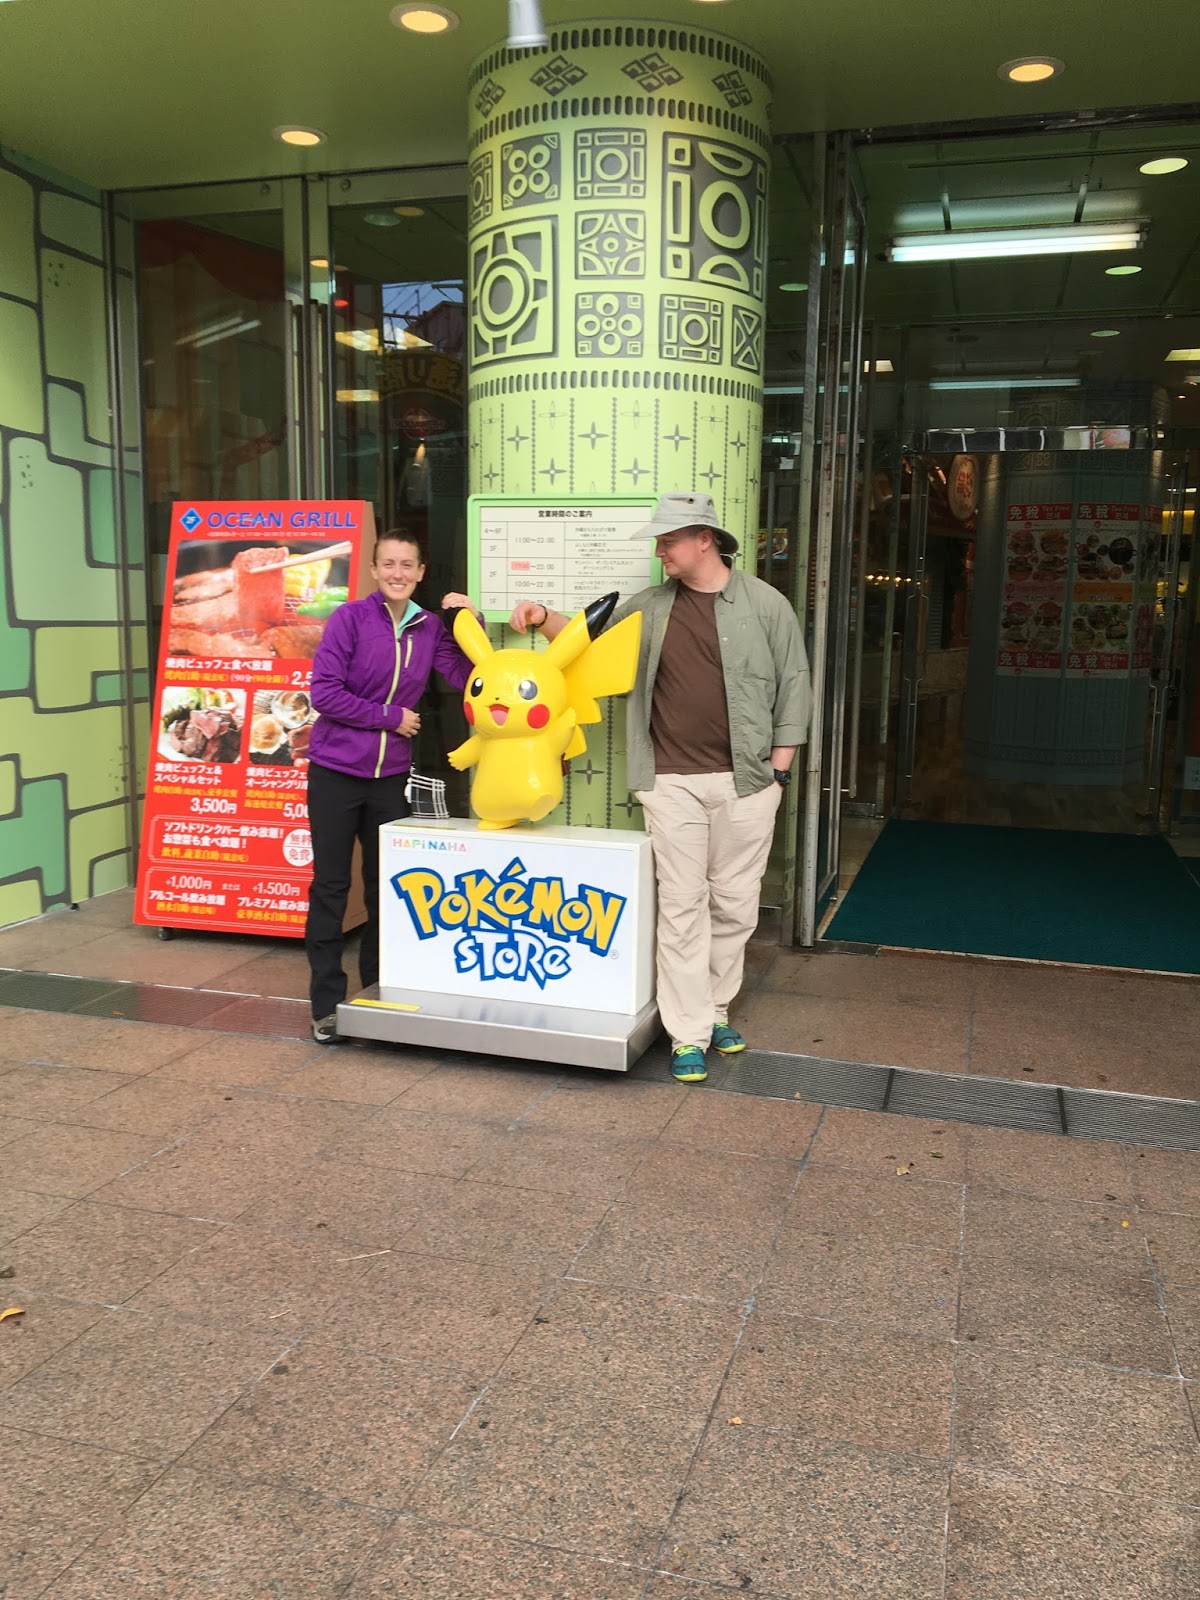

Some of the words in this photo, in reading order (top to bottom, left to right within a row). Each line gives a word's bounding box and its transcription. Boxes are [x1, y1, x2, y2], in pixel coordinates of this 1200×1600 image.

[207, 511, 283, 528] OCEAN
[290, 511, 357, 529] GRILL
[538, 510, 592, 518] 営業時間のご案内
[153, 773, 221, 785] スペシャルセット
[190, 797, 237, 814] 3,500円
[165, 875, 213, 890] +1,000円
[149, 890, 226, 906] アルコール飲み放題
